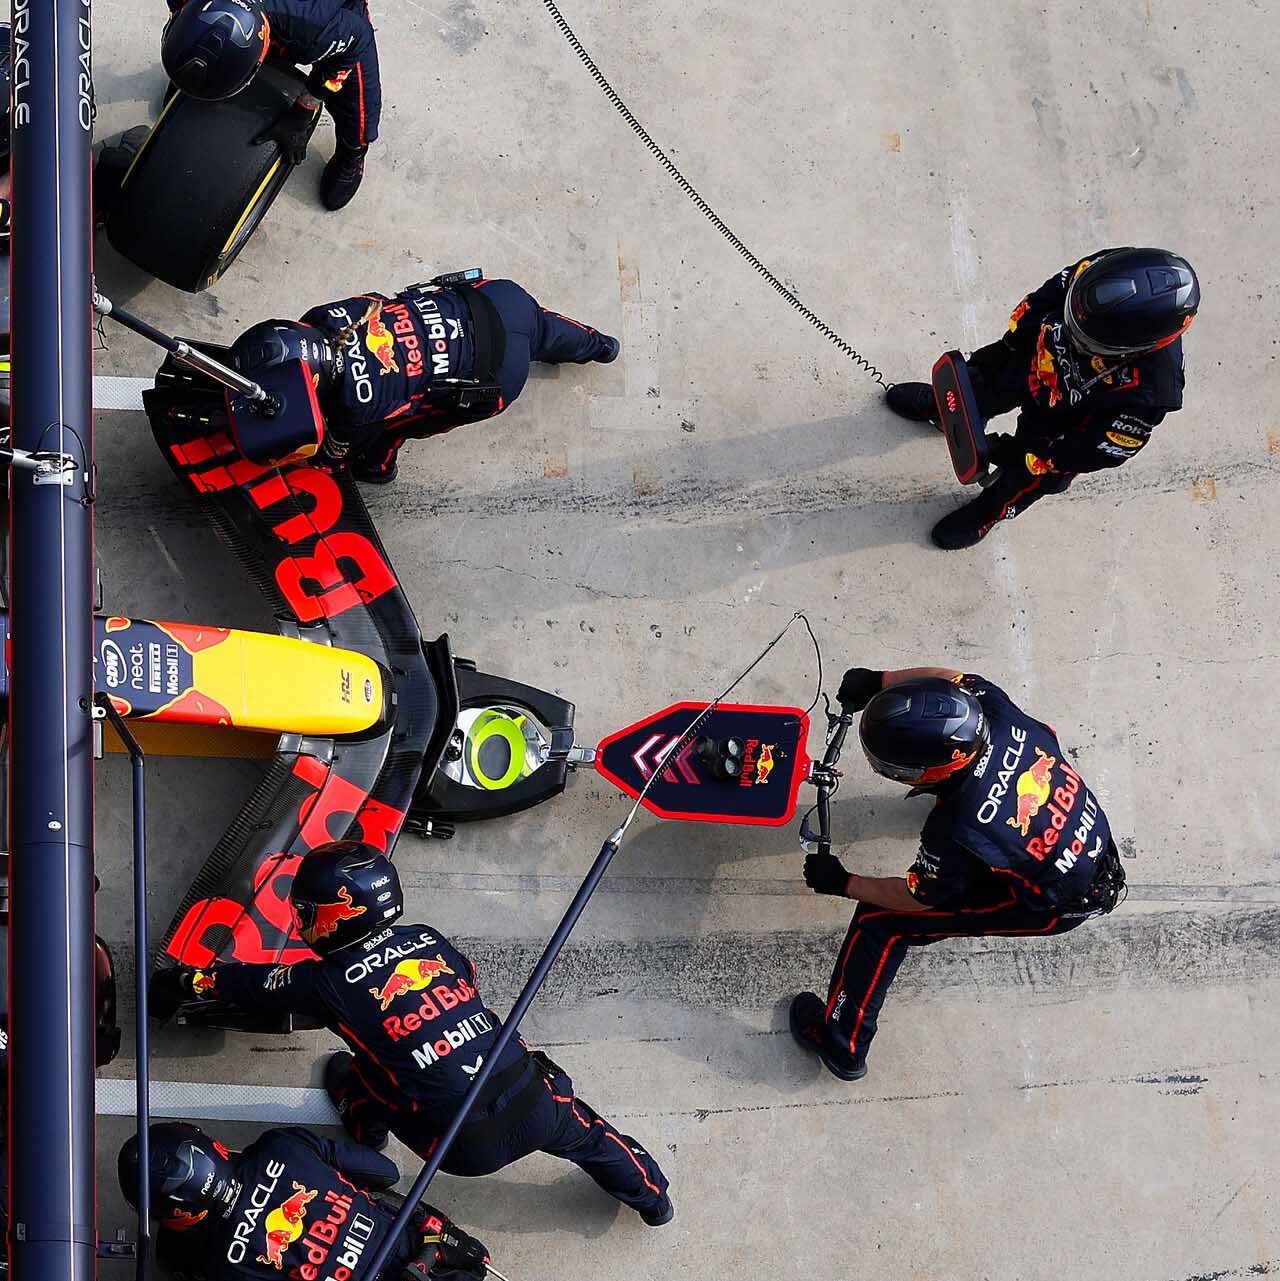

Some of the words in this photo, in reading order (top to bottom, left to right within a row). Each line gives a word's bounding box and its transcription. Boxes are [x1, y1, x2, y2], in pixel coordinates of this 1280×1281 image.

[79, 0, 91, 130] ORACL
[382, 302, 416, 336] Bull
[422, 312, 450, 376] Mobil
[395, 333, 424, 378] Red
[106, 649, 119, 688] CDW
[148, 642, 161, 693] PIRELLI
[166, 658, 179, 695] Mobil
[739, 764, 755, 788] Bull
[744, 739, 759, 763] Red
[976, 726, 1027, 824] ORACLE
[1025, 802, 1068, 861] Red
[1054, 813, 1095, 874] Mobil
[345, 932, 437, 984] ORACLE
[381, 993, 441, 1042] Red
[411, 1018, 476, 1070] Mobil
[227, 1158, 286, 1264] ORACLE
[307, 1188, 354, 1246] Bull
[324, 1235, 366, 1281] obil
